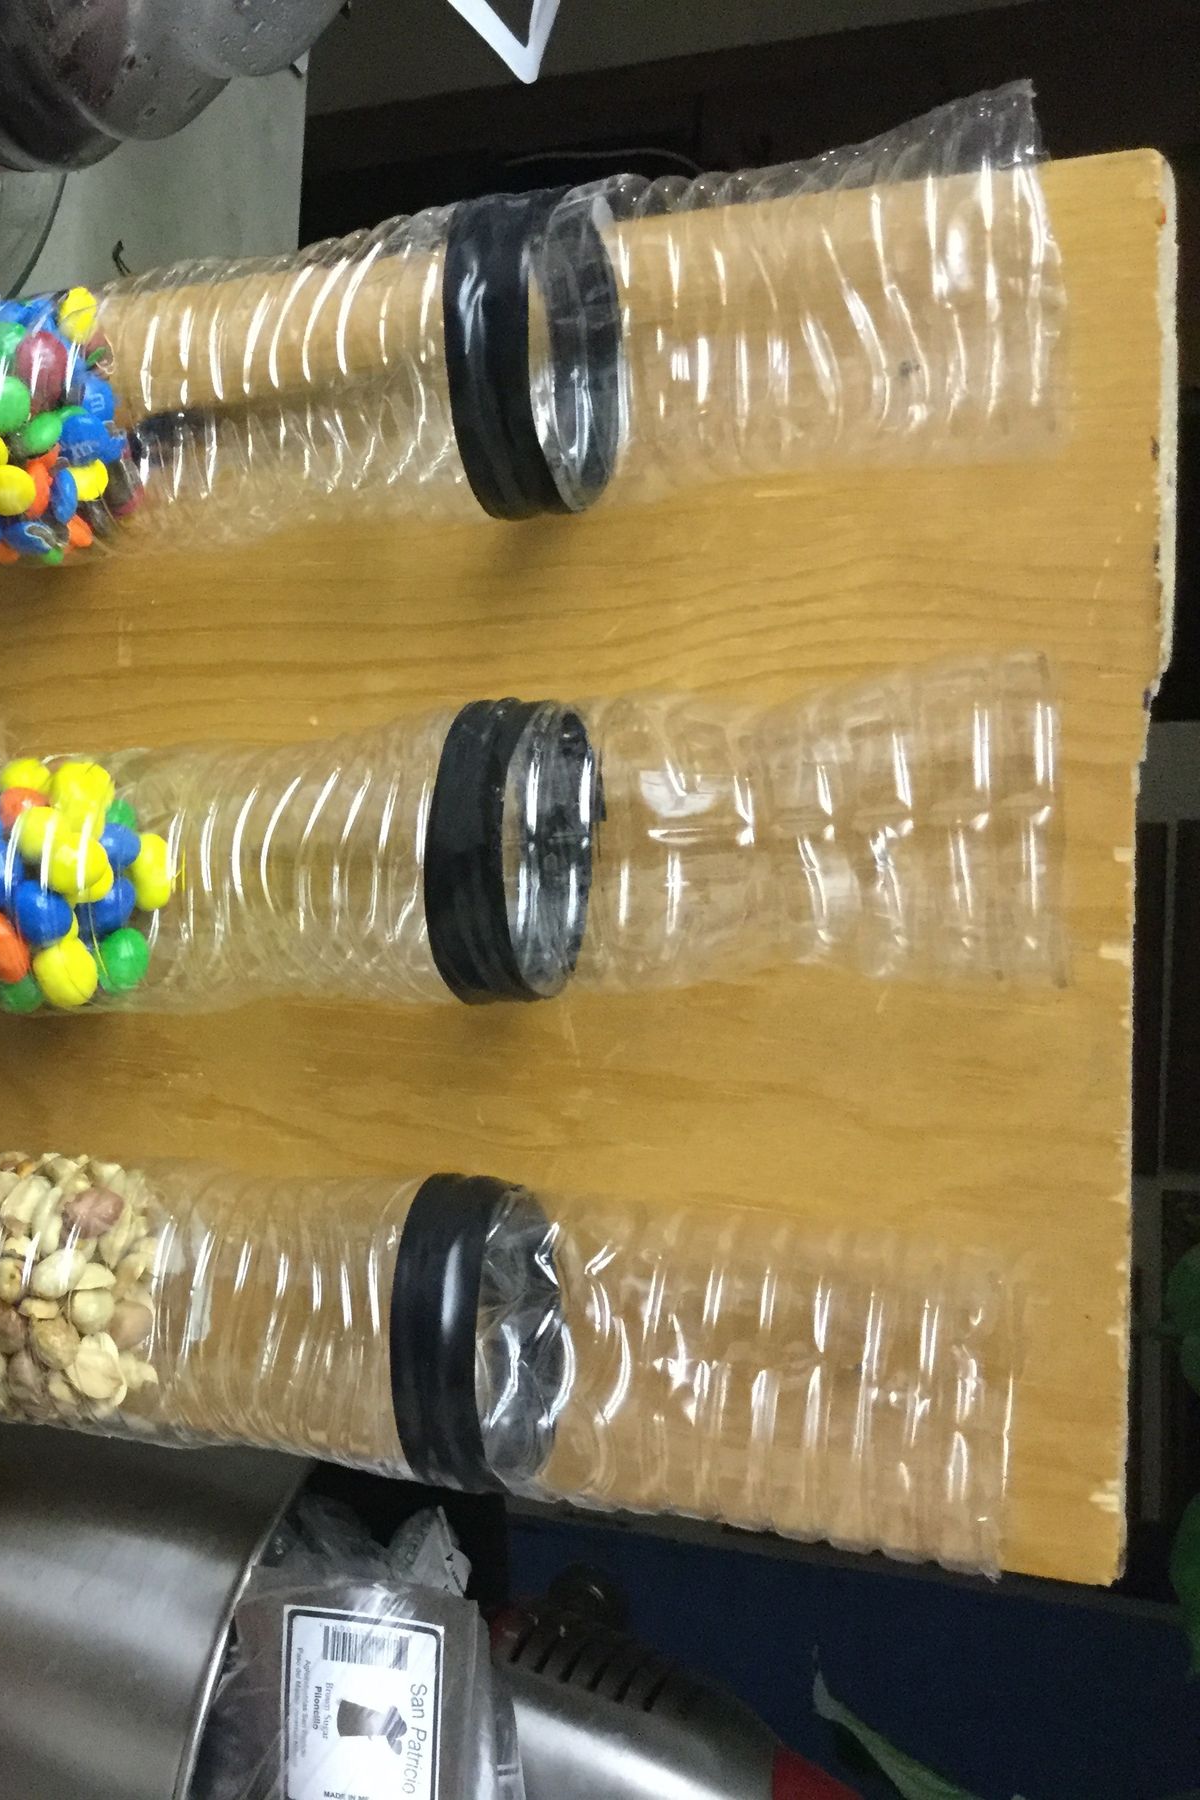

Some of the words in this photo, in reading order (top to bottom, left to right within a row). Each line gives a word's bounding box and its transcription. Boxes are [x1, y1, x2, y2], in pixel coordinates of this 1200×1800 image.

[312, 1685, 323, 1730] Piloncillo
[410, 1683, 428, 1719] San
[322, 1714, 332, 1740] Sugar
[402, 1725, 427, 1794] Patricio
